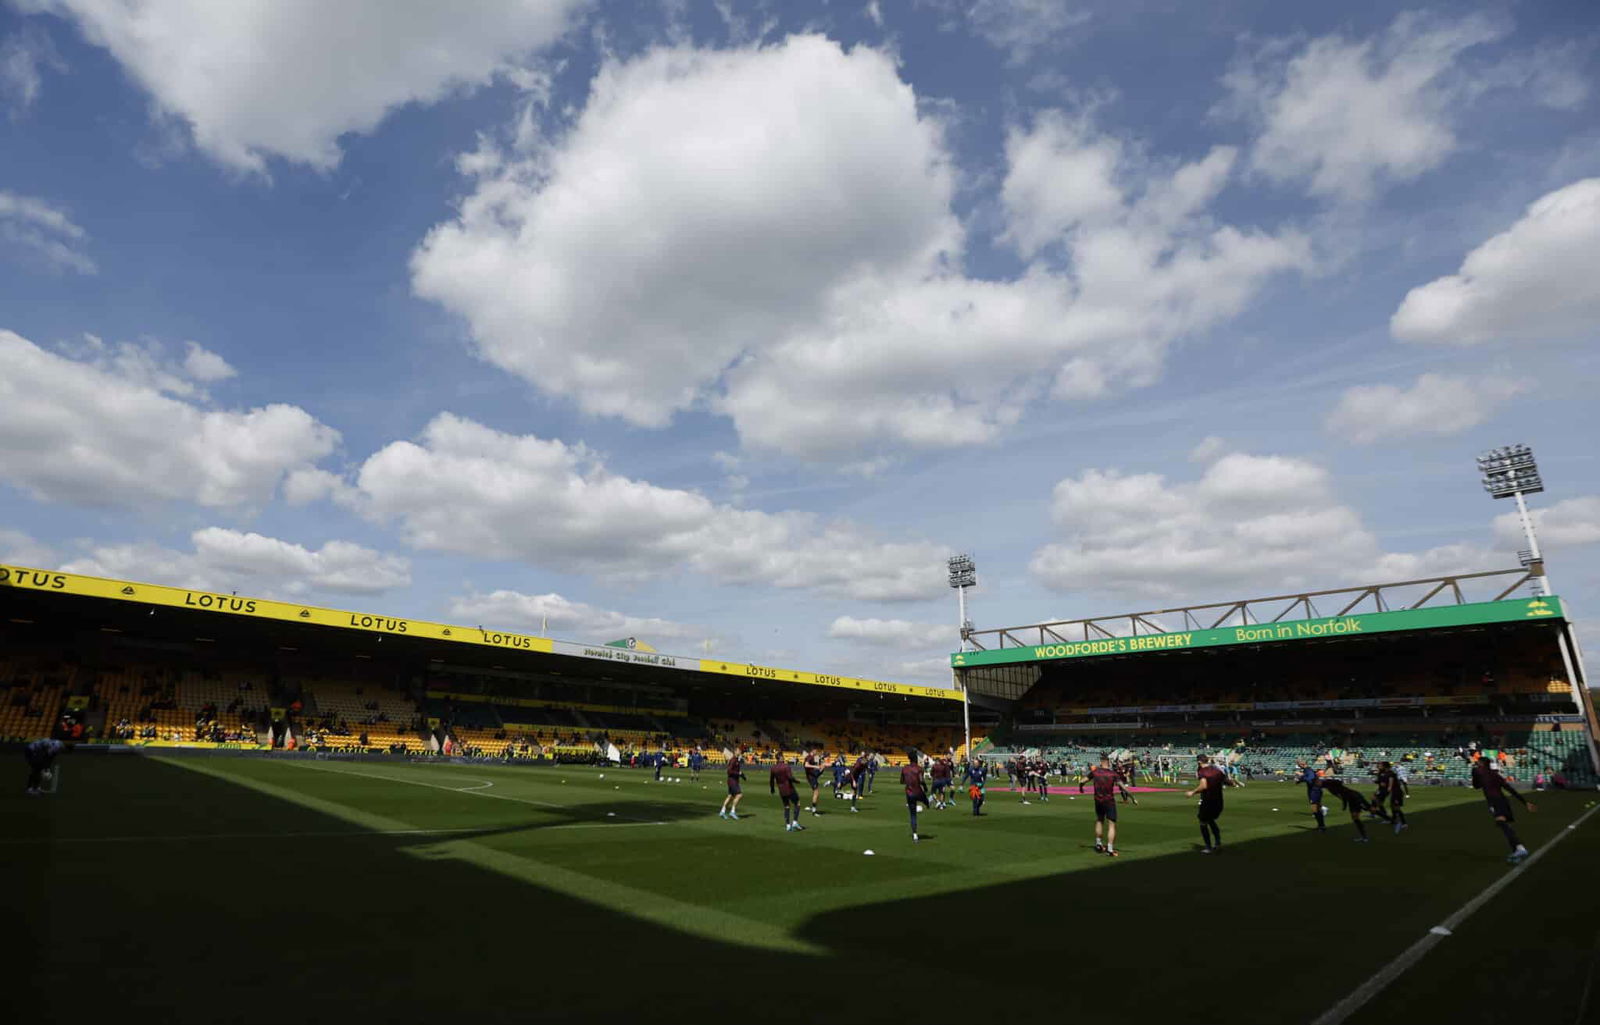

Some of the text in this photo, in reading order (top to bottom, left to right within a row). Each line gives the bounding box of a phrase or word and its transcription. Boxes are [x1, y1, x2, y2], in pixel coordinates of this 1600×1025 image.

[185, 592, 256, 613] LOTUS
[350, 614, 407, 633] LOTUS
[1235, 618, 1362, 642] Born in Norfolk
[483, 632, 531, 648] LOTUS
[1034, 633, 1193, 658] WOODFORDE'S BREWERY
[746, 666, 776, 678] LOTUS
[815, 674, 841, 686] LOTUS
[874, 682, 897, 692] LOTUS
[925, 687, 945, 698] LOTUS
